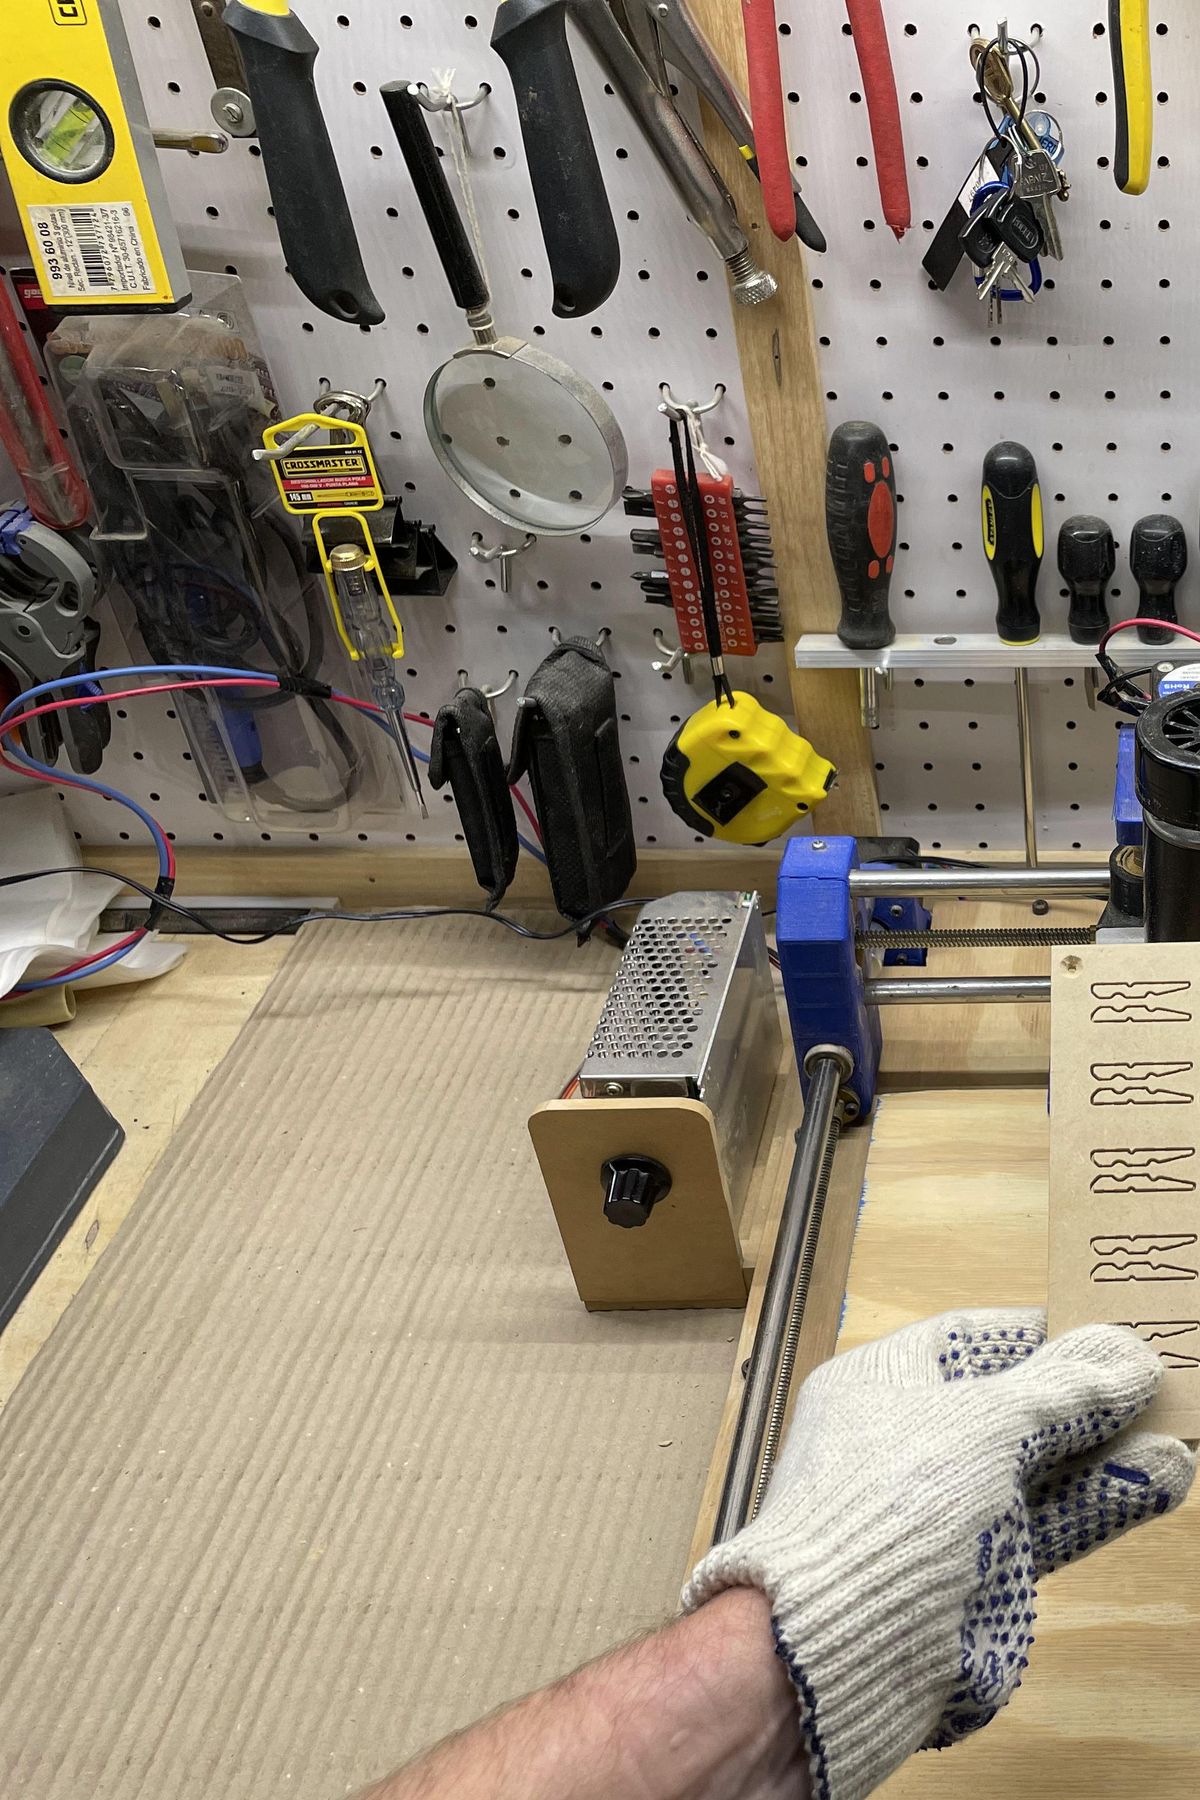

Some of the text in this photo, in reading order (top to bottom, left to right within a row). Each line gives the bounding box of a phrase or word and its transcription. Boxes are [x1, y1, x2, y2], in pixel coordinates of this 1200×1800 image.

[38, 222, 62, 279] 993 60 08
[129, 226, 138, 245] China
[114, 254, 128, 290] Importador
[139, 258, 150, 290] Fabricado
[284, 459, 359, 469] CROSSMASTER
